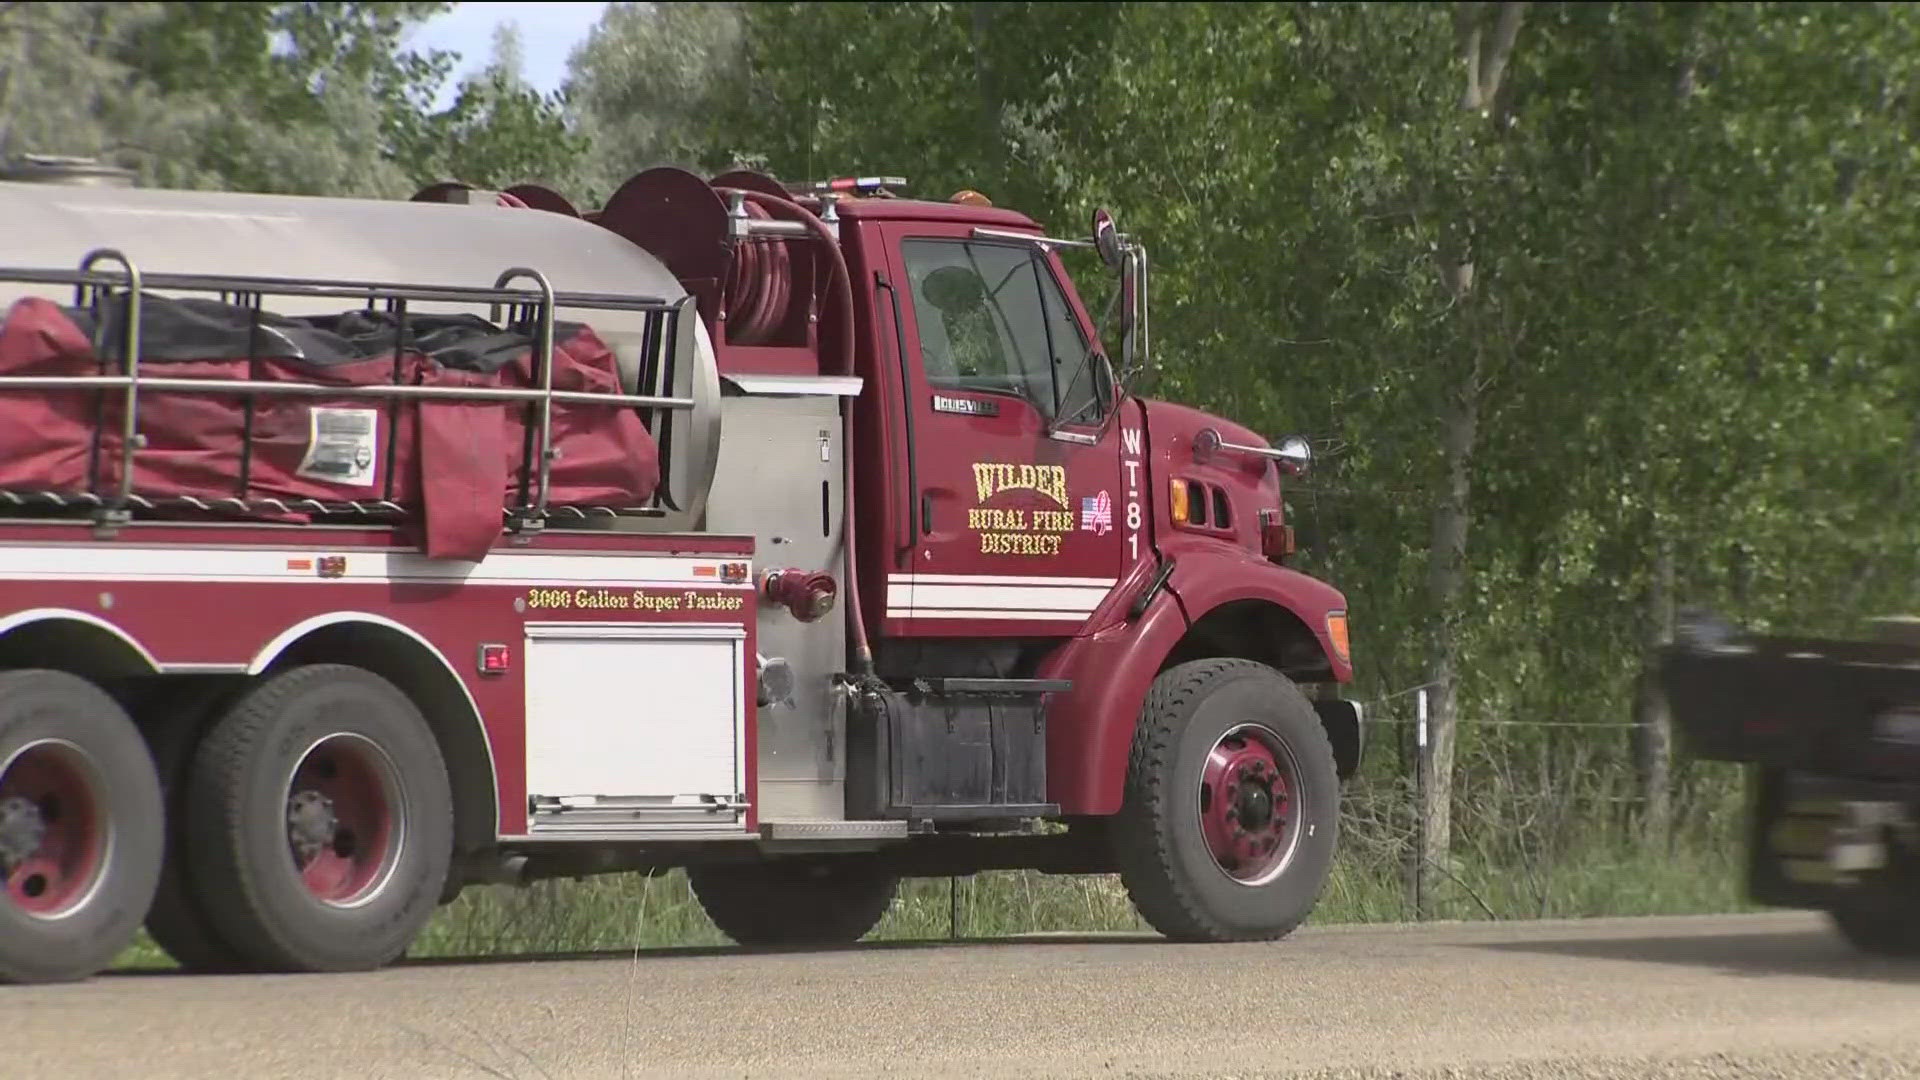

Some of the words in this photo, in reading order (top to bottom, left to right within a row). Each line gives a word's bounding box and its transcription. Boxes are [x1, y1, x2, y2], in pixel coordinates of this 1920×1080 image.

[973, 462, 1069, 509] WILDER
[1122, 428, 1142, 560] WT-81
[968, 509, 1028, 530] RURAL
[1033, 511, 1074, 532] FIRE
[980, 533, 1062, 556] DISTRICT
[528, 589, 571, 609] 3000
[575, 589, 628, 608] Gallon
[633, 590, 681, 612] Super
[684, 591, 744, 610] Tanker
